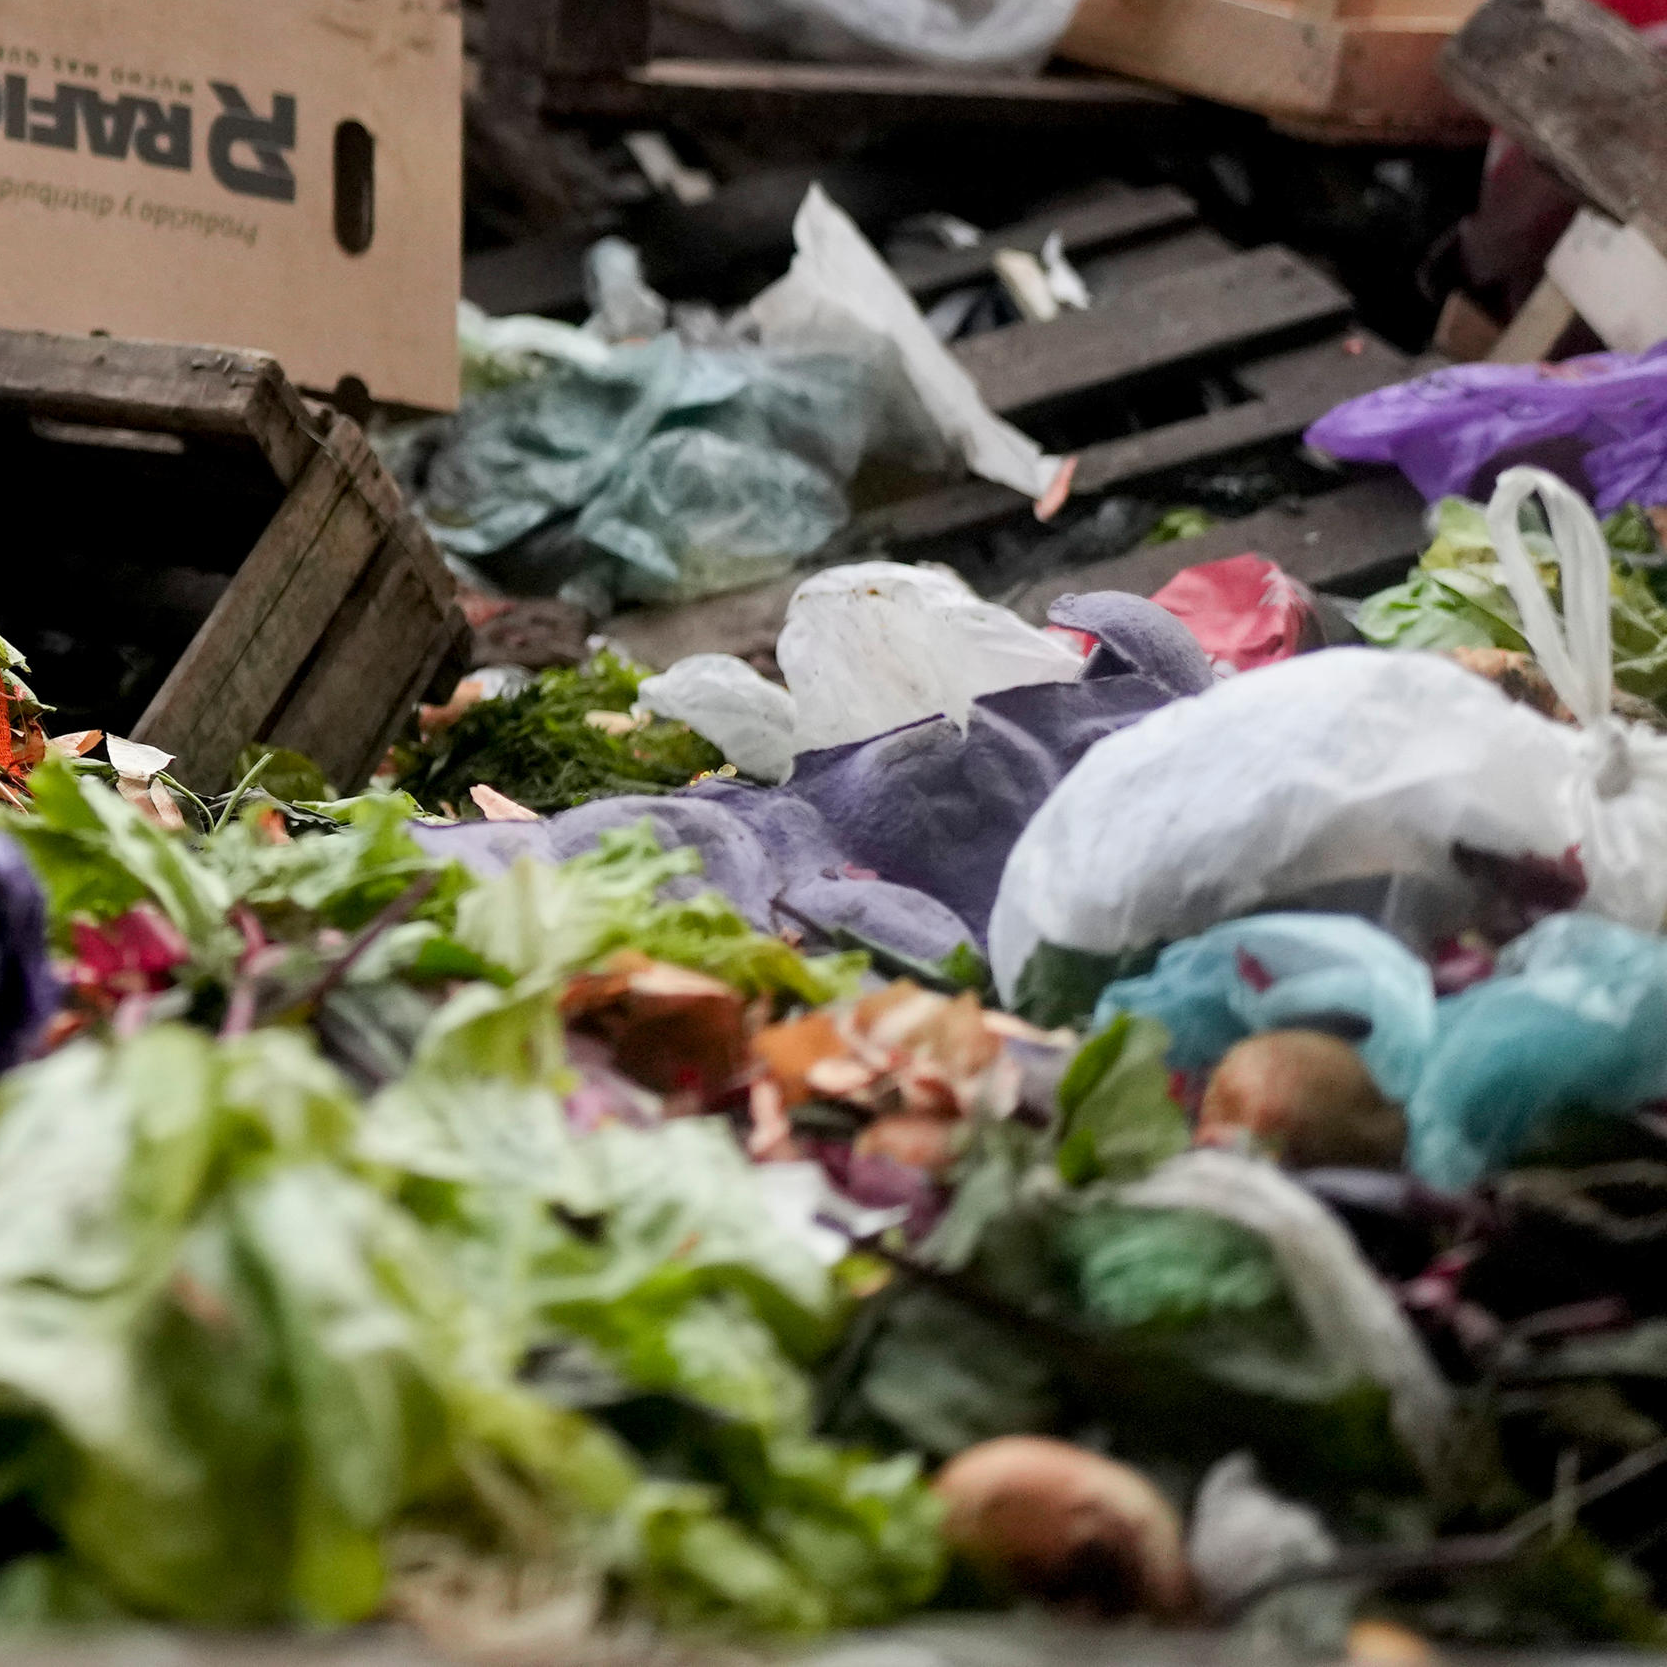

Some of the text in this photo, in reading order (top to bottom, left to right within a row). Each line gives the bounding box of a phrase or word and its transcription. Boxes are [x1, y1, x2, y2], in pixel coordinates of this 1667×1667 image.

[109, 64, 195, 94] MUCHO
[121, 195, 137, 221] y
[141, 201, 260, 246] Producido
